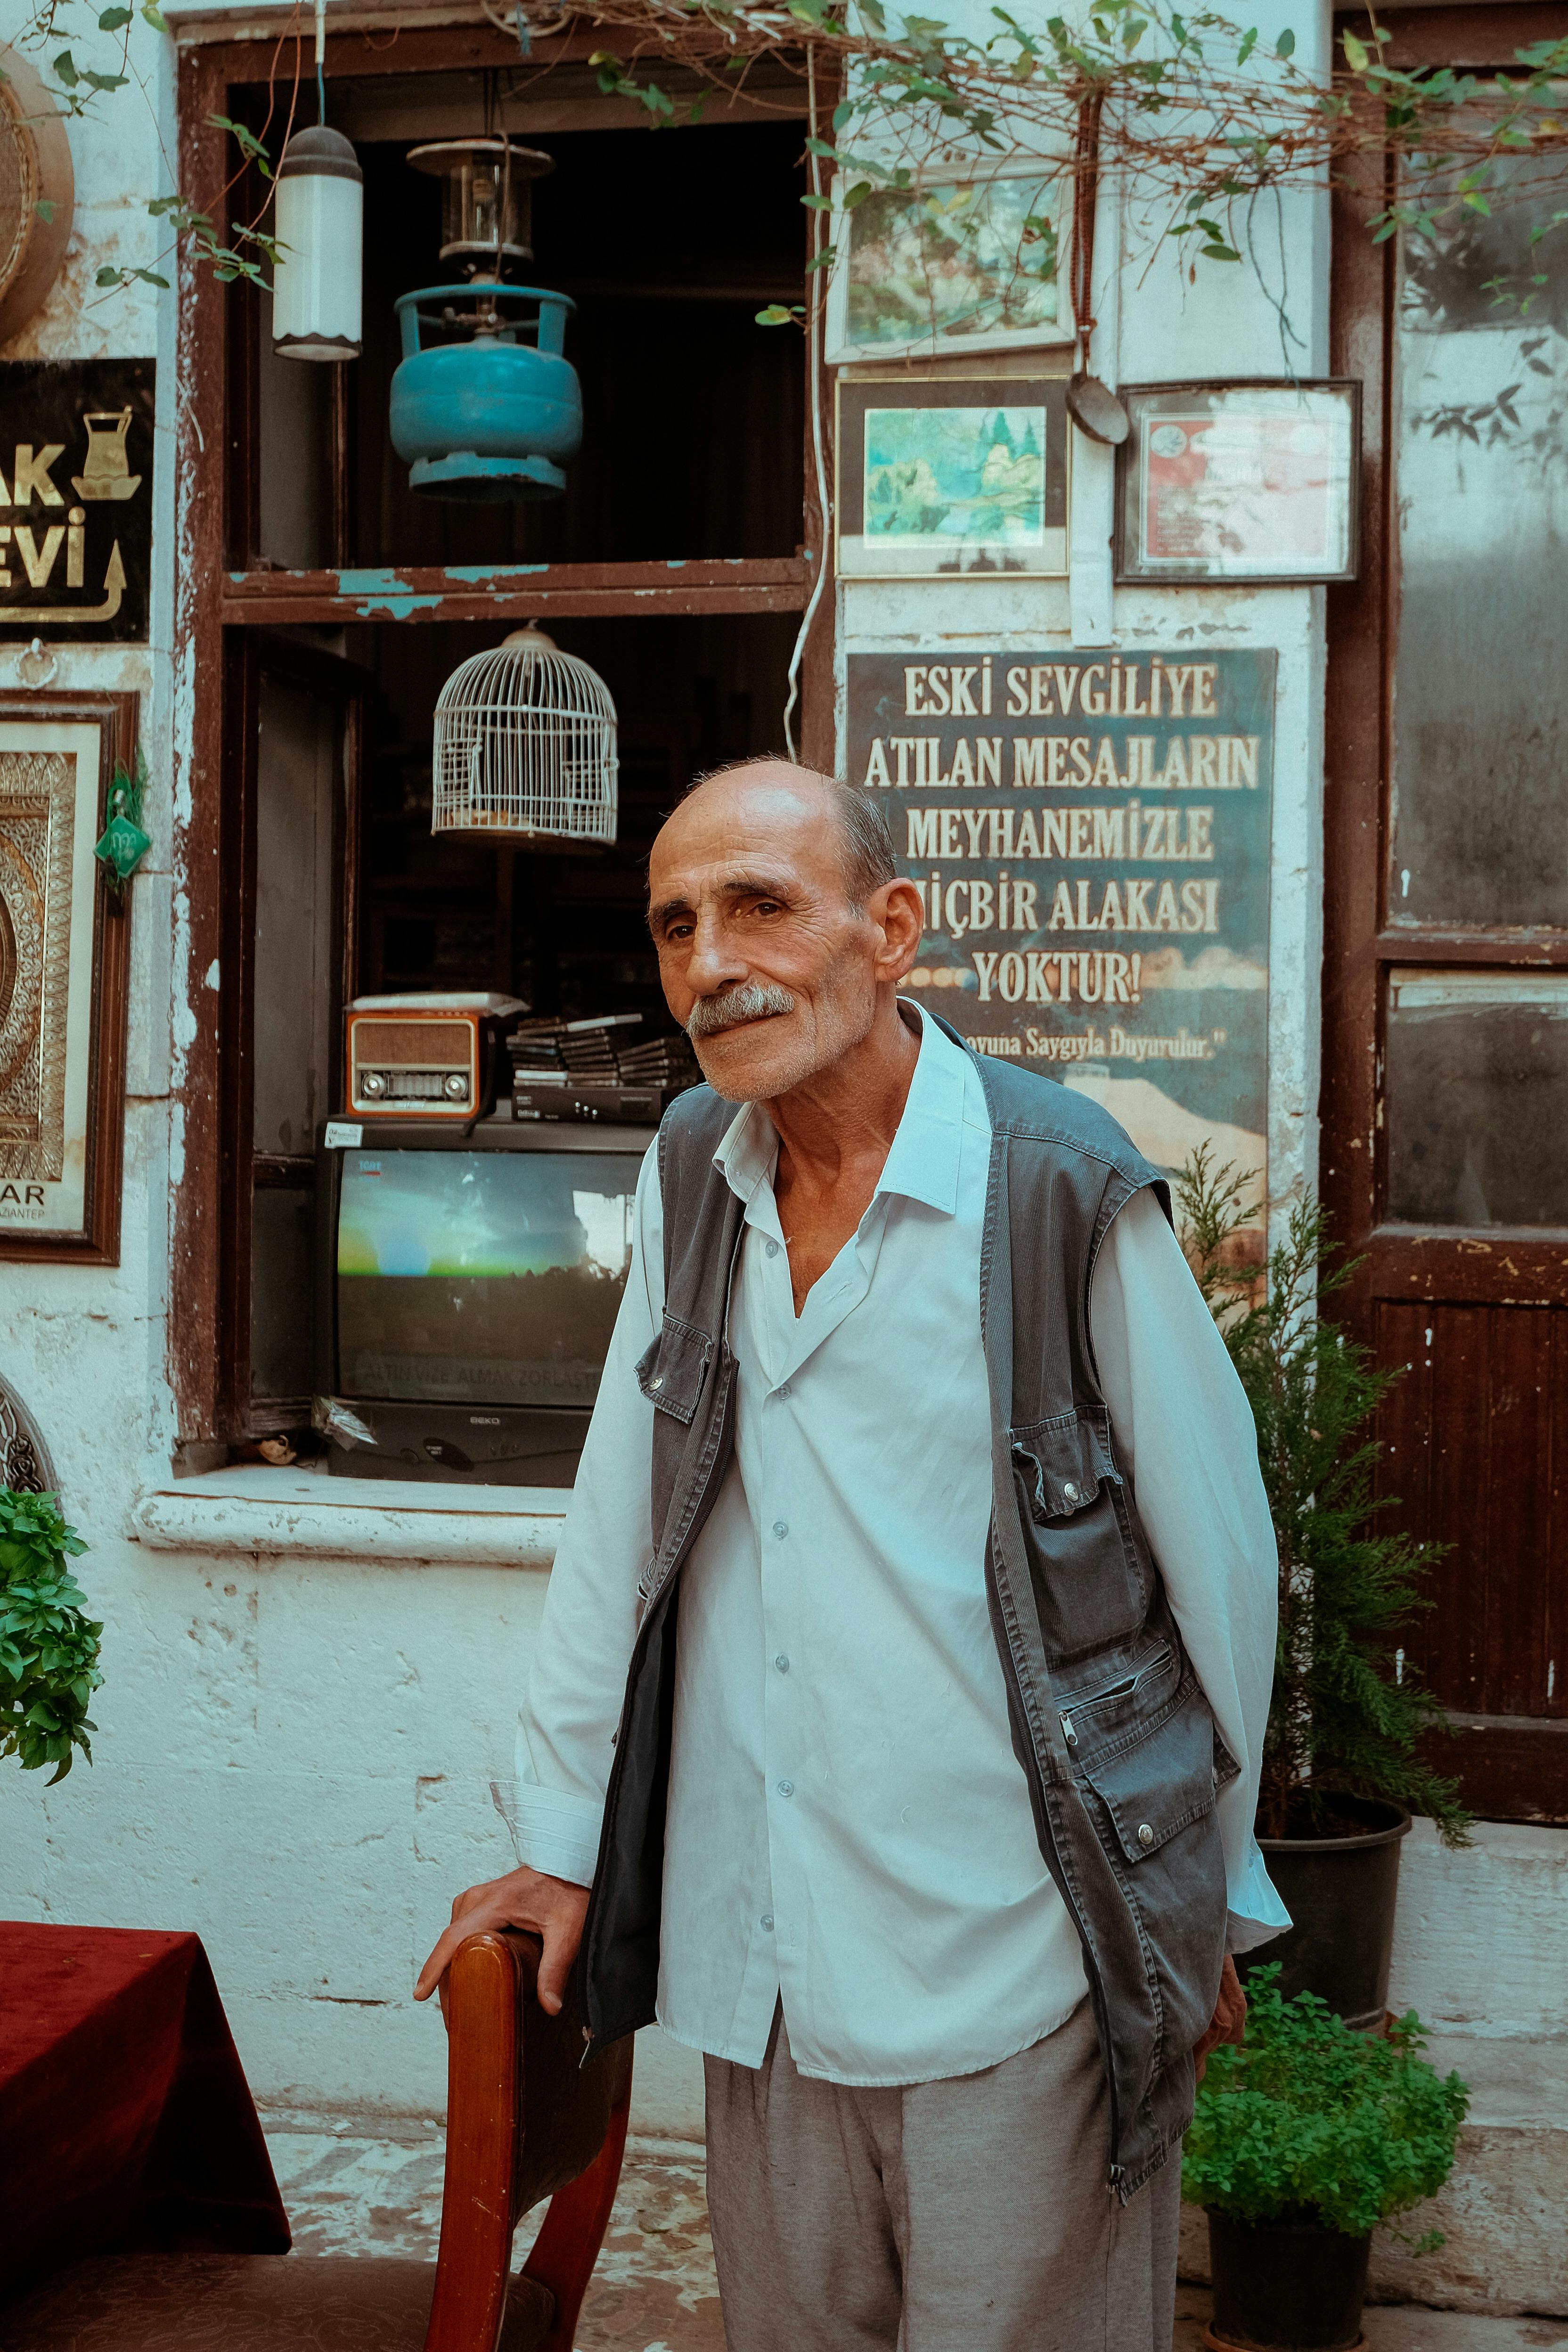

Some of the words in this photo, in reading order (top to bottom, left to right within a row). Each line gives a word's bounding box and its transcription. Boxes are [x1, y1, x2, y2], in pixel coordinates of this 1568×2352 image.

[0, 444, 66, 506] K
[904, 657, 992, 716] ESKİ
[1007, 657, 1218, 717] SEVGİLİYE
[864, 736, 1003, 788] ATILAN
[1013, 735, 1261, 789] MESAJLARIN
[906, 799, 1215, 861] MEYHANEMİZLE
[1048, 878, 1221, 932] ALAKASI
[972, 951, 1142, 1004] YOKTUR!
[966, 1036, 1023, 1056] oyuna
[1026, 1027, 1106, 1062] Saygıyla
[470, 1417, 500, 1425] BEKO
